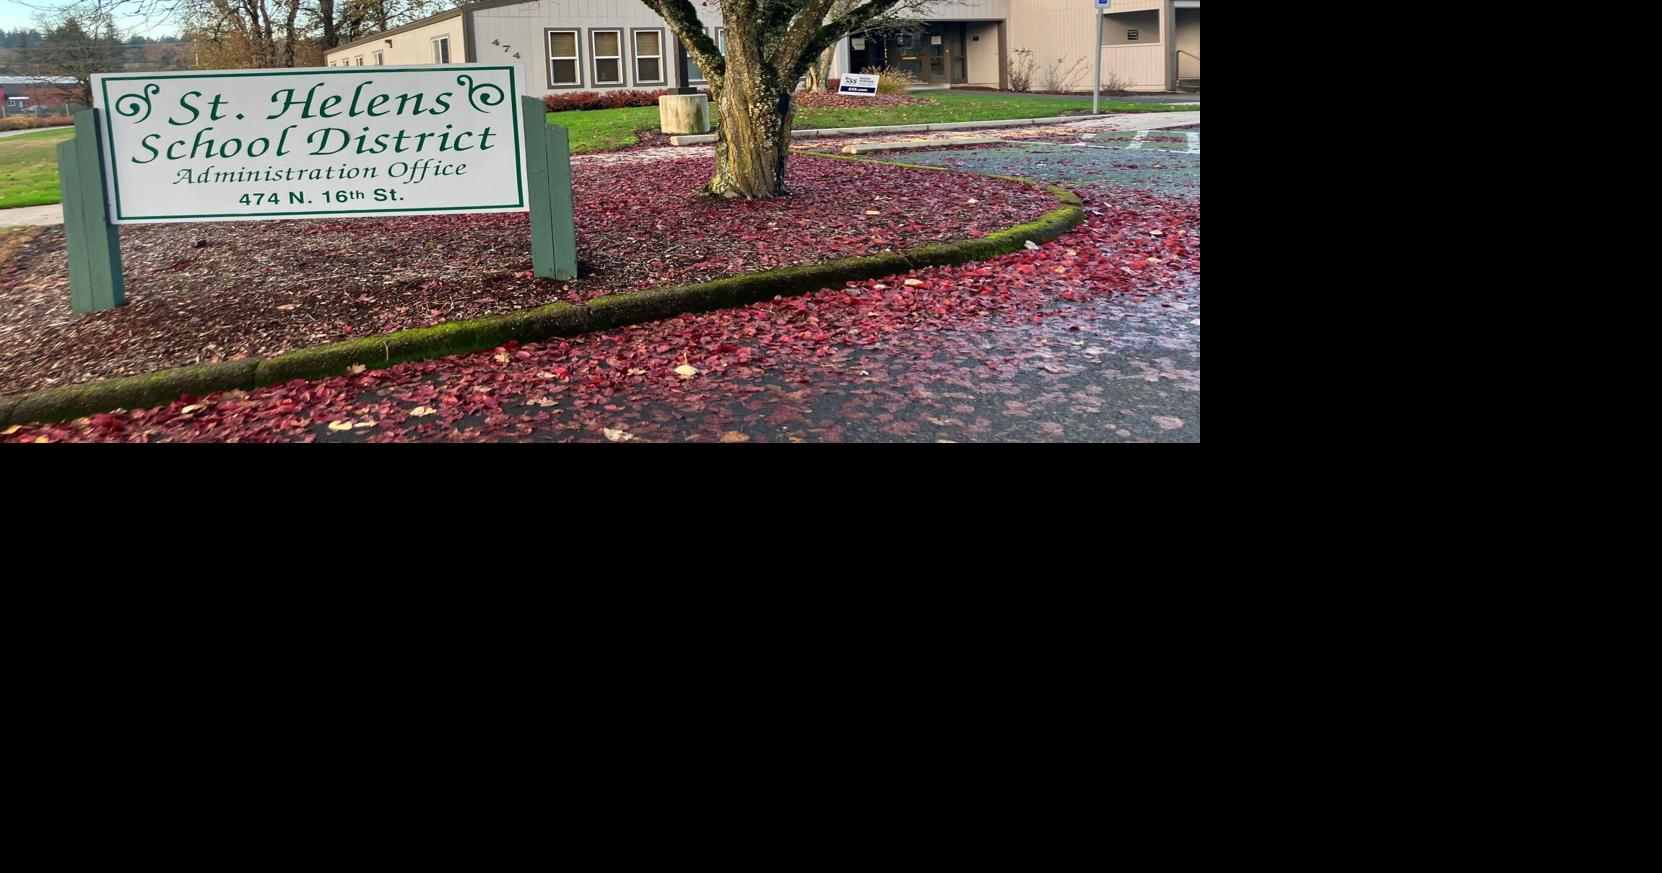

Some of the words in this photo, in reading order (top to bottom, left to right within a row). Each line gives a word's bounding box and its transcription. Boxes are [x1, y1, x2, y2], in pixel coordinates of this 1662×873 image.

[491, 38, 521, 60] 474
[168, 91, 246, 126] St.
[266, 80, 454, 121] Helens
[131, 125, 298, 164] School
[306, 124, 497, 156] District
[172, 165, 377, 185] Administration
[388, 159, 468, 184] Office
[238, 192, 280, 206] 474
[288, 191, 313, 205] N.
[322, 189, 365, 204] 16th
[373, 188, 405, 202] St.
